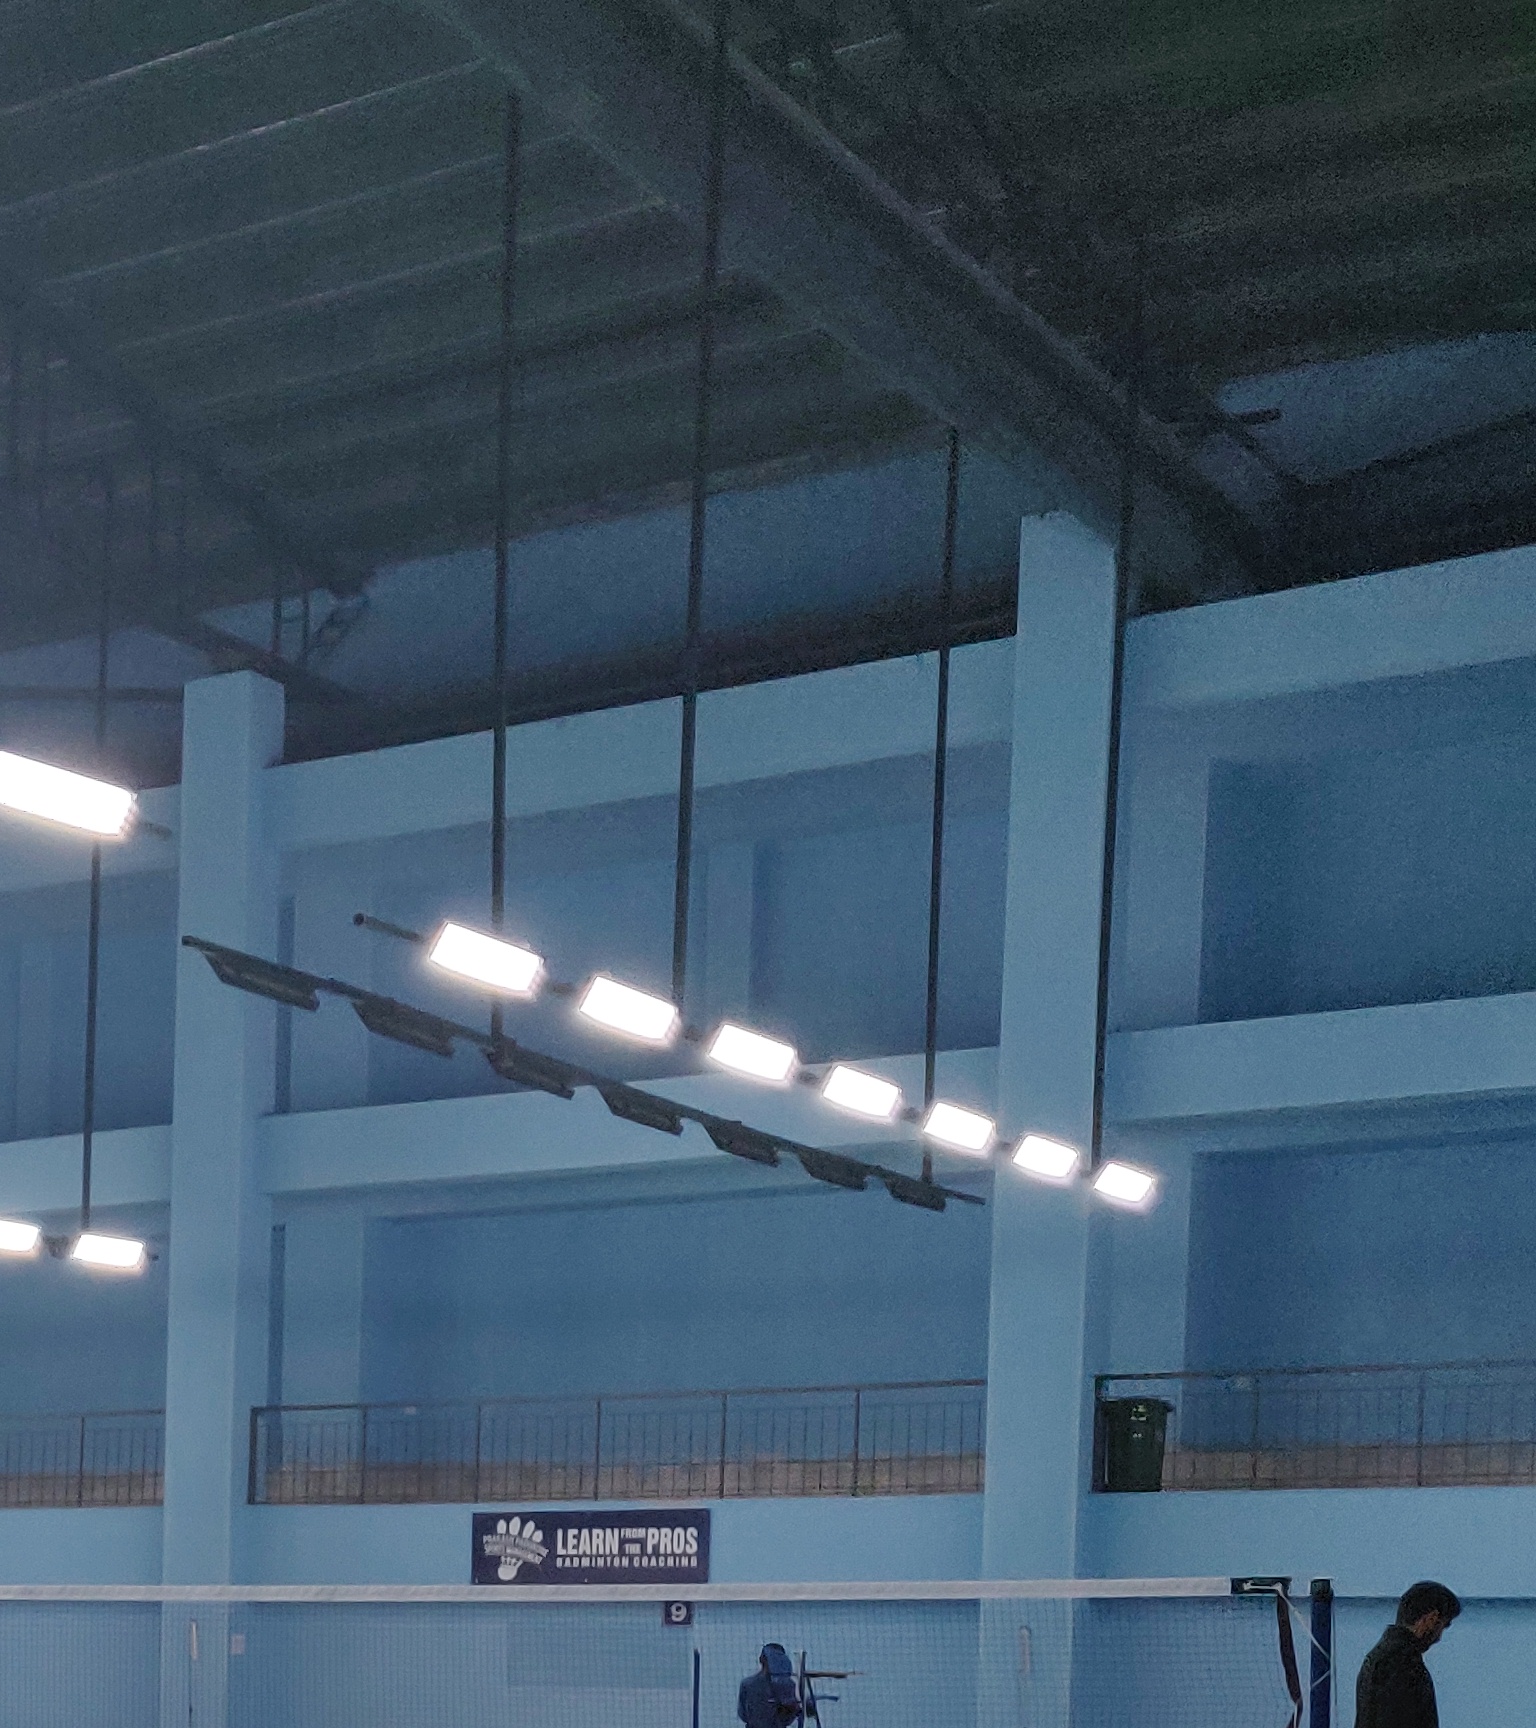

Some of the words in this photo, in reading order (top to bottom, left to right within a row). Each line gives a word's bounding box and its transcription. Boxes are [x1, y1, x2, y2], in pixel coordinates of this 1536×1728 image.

[556, 1528, 620, 1555] LEARN
[620, 1527, 646, 1539] FROM
[646, 1527, 698, 1555] PROS
[556, 1555, 629, 1568] BADMINTON
[670, 1602, 687, 1622] 9
